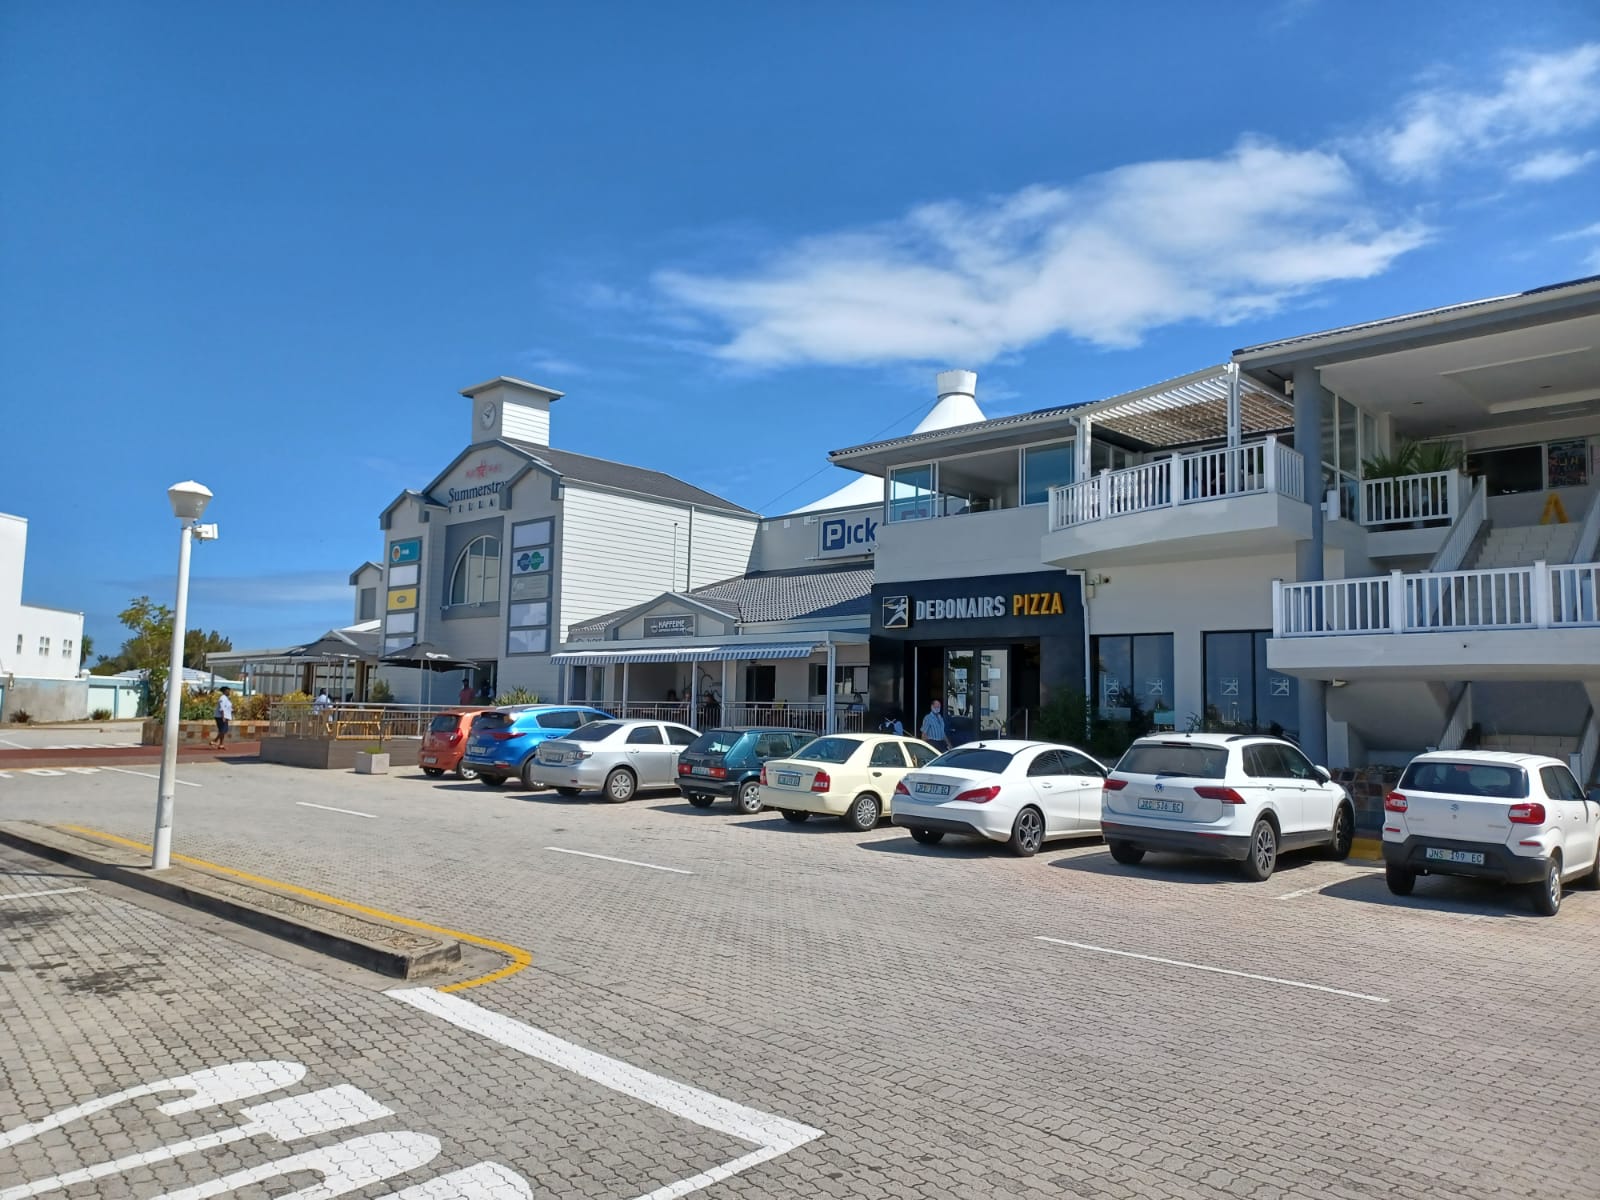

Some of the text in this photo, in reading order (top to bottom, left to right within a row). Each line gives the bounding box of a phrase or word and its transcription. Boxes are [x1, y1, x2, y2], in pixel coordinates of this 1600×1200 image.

[448, 481, 508, 503] Summerstr
[448, 498, 494, 514] VILLA
[823, 517, 878, 551] Pick
[915, 592, 1064, 621] DEBONAIRS PIZZA
[1429, 849, 1445, 859] JNS
[1471, 854, 1482, 863] EC
